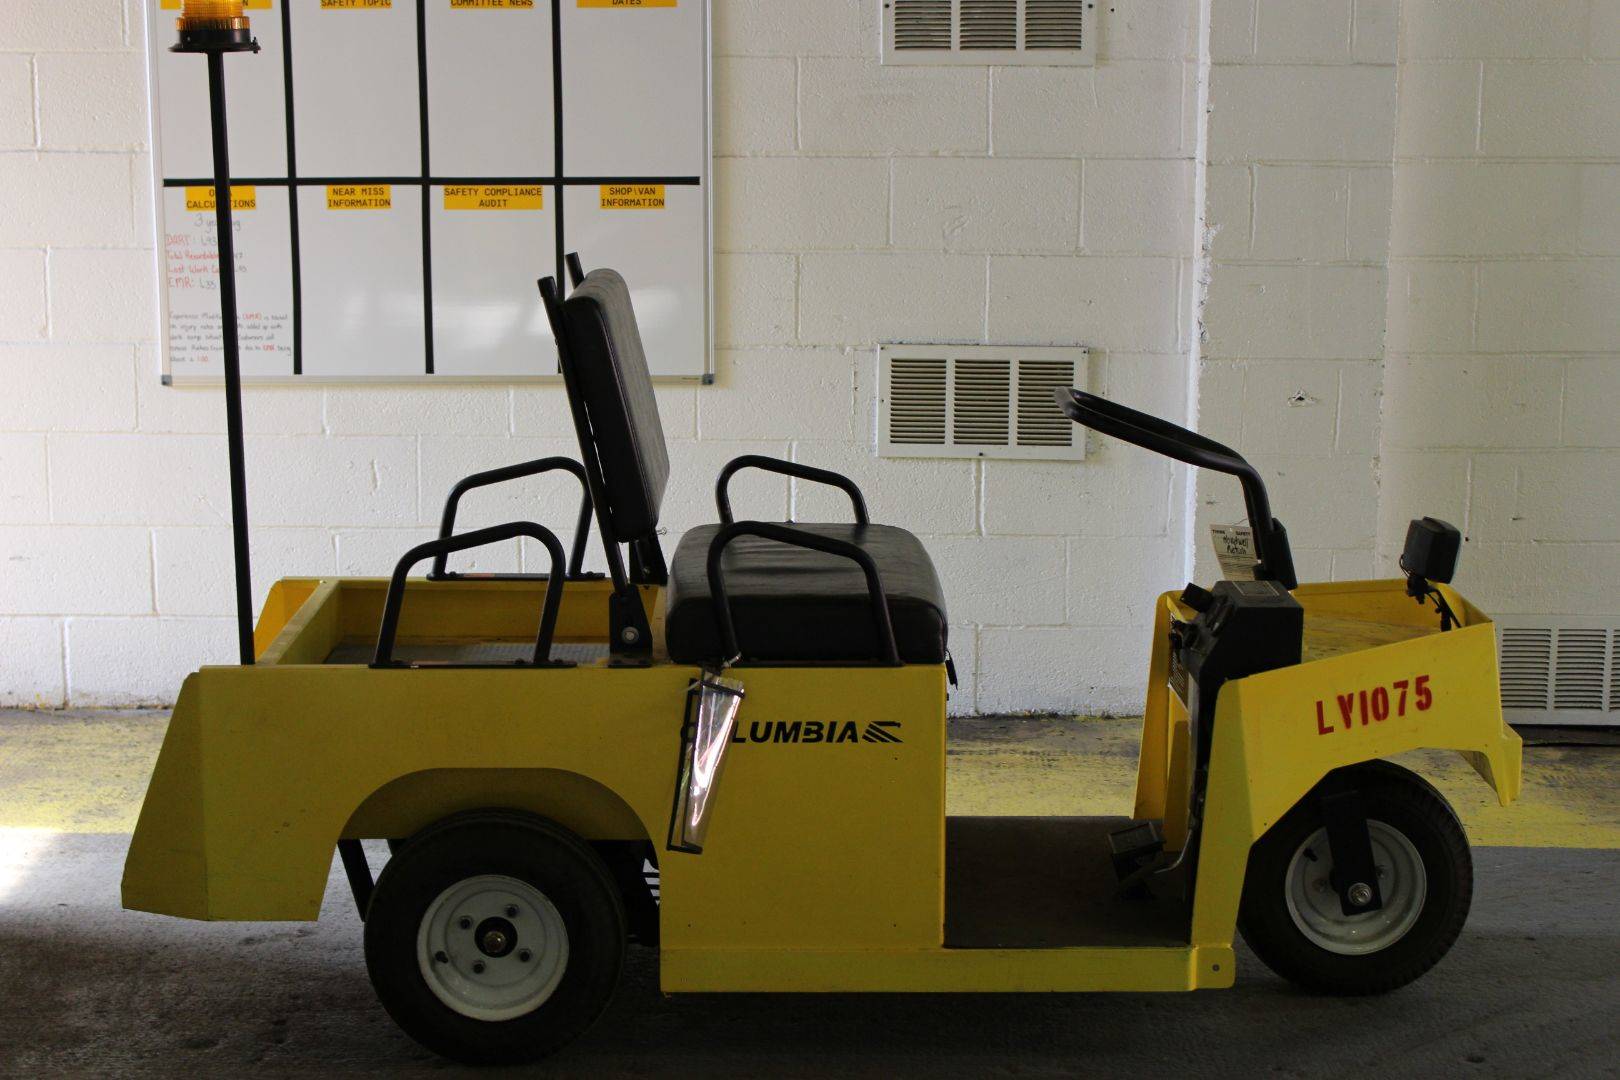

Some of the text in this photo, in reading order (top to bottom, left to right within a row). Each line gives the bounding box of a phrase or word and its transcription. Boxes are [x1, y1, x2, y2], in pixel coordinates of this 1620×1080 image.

[332, 187, 385, 197] NEAR MISS
[444, 187, 542, 197] SAFETY COMPLIANCE
[186, 199, 256, 209] CALCUIONS
[327, 198, 392, 208] INFORMATION
[478, 198, 508, 208] AUDIT
[601, 198, 665, 207] INFORMATION
